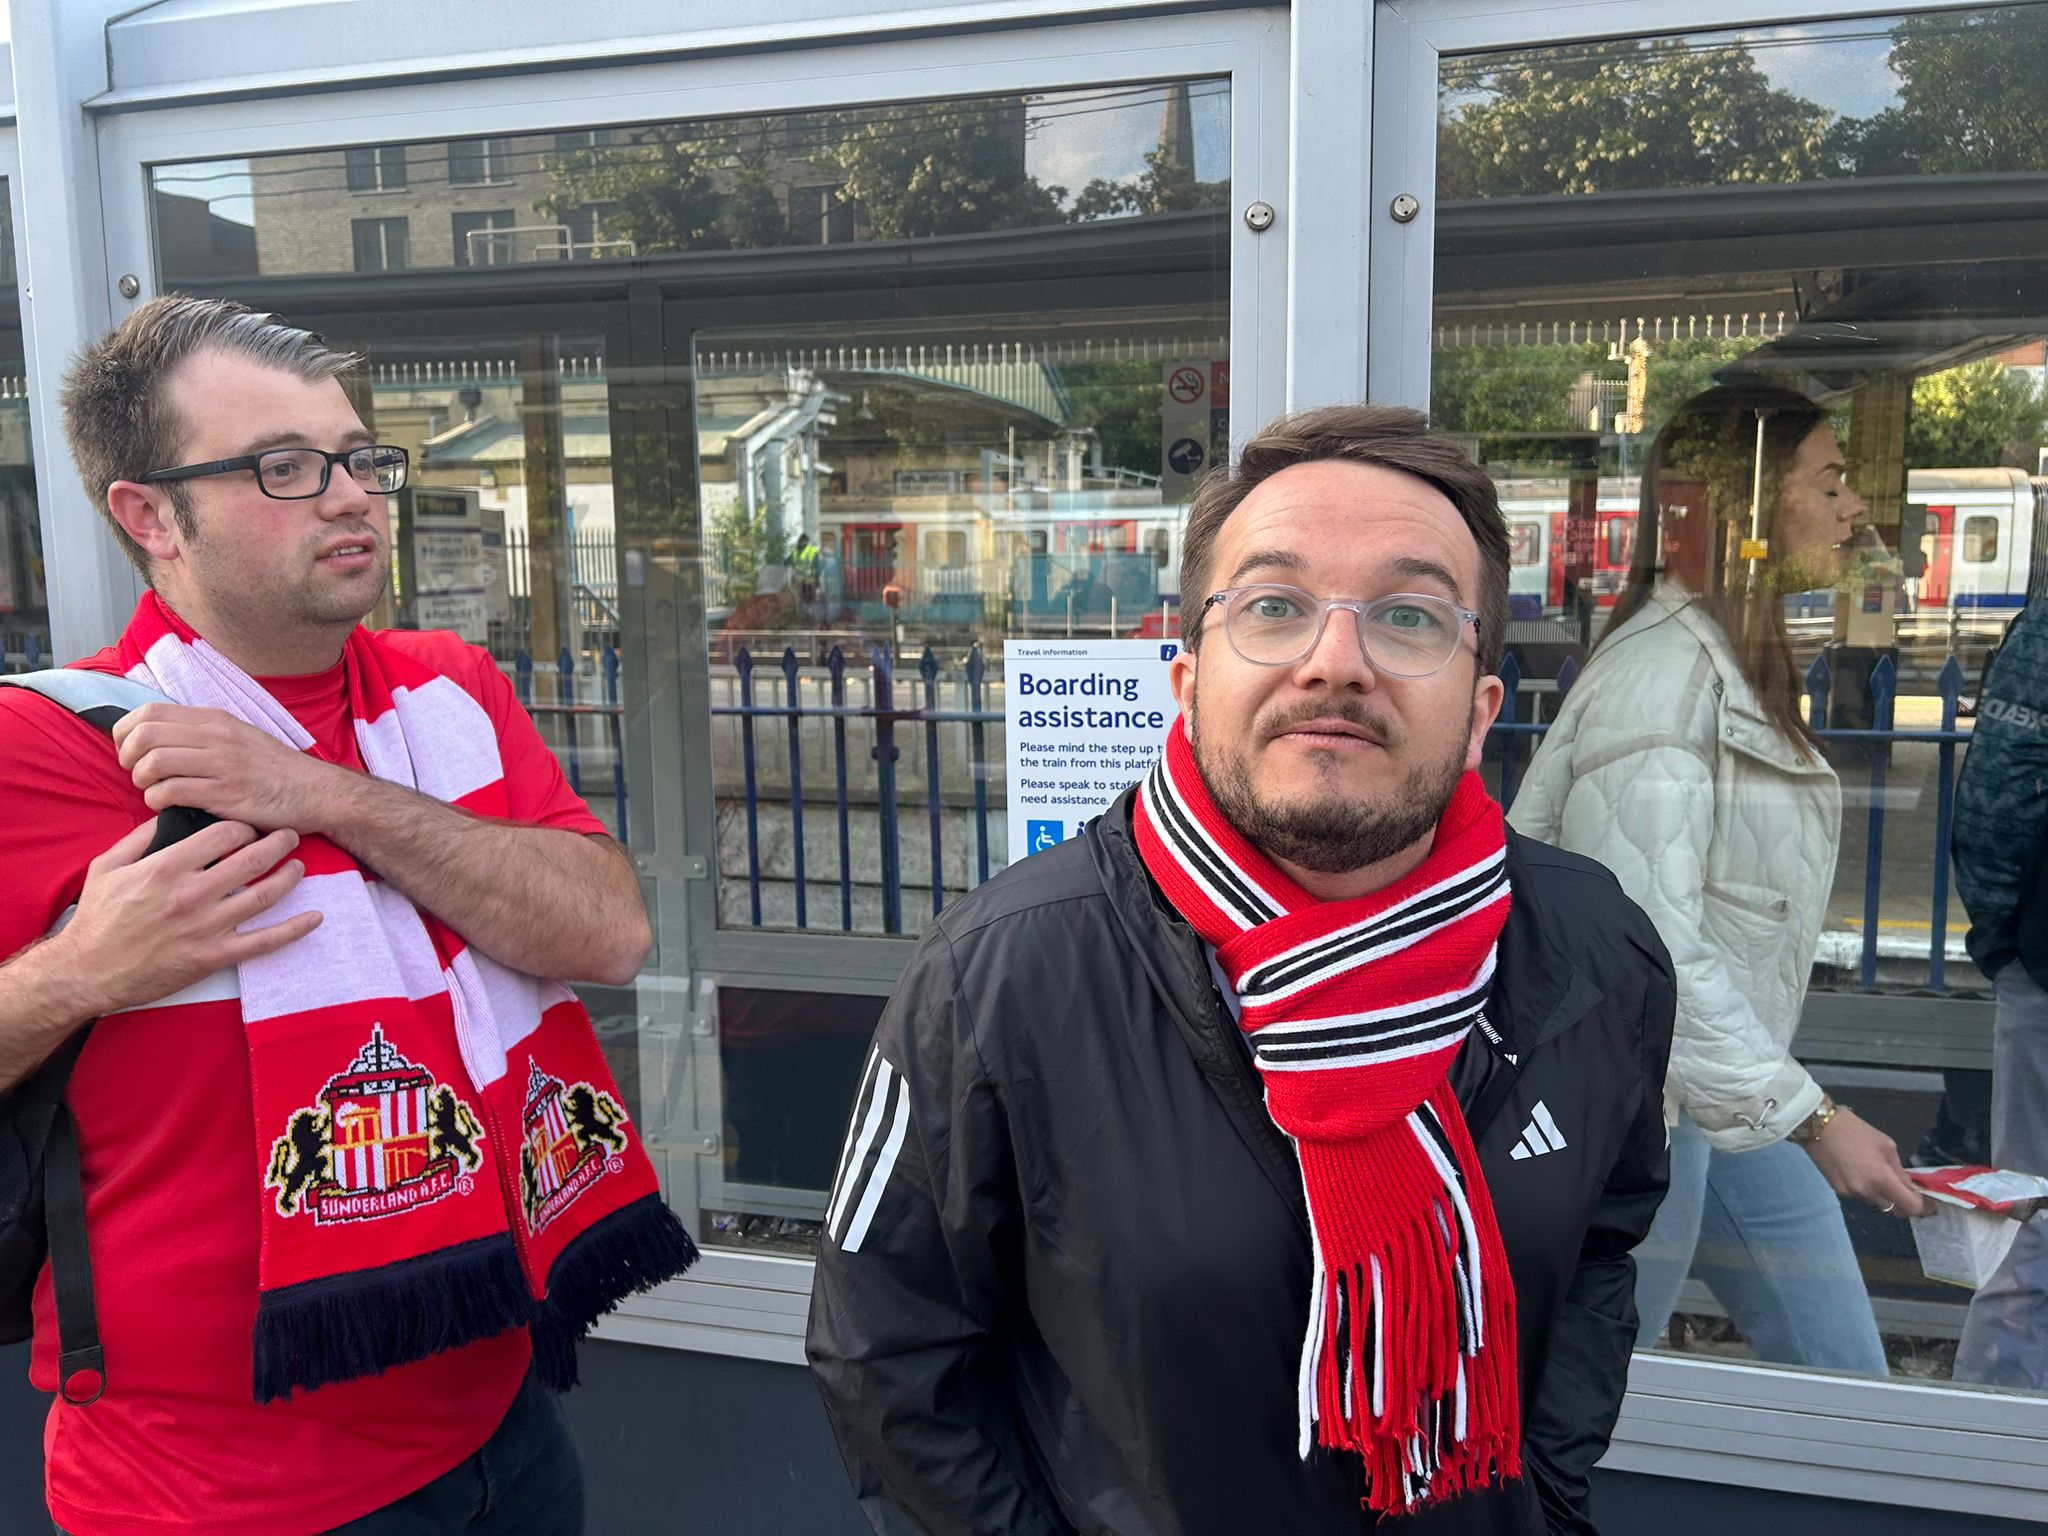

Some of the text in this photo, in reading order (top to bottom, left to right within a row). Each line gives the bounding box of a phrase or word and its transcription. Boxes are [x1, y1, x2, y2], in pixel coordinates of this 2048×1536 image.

[1017, 649, 1088, 657] Travel information
[1019, 673, 1139, 701] Boarding
[1018, 705, 1164, 729] assistance
[1020, 742, 1055, 753] Please
[1058, 743, 1085, 753] mind
[1088, 743, 1107, 753] the
[1111, 744, 1136, 756] step
[1139, 745, 1153, 756] up
[1020, 757, 1039, 768] the
[1042, 758, 1067, 768] train
[1070, 758, 1096, 769] from
[1100, 758, 1121, 769] this
[1021, 779, 1055, 790] Please
[1059, 779, 1090, 792] speak
[1094, 781, 1106, 791] to
[1021, 794, 1110, 806] need assistance.
[321, 1187, 418, 1216] SUNDERLAND
